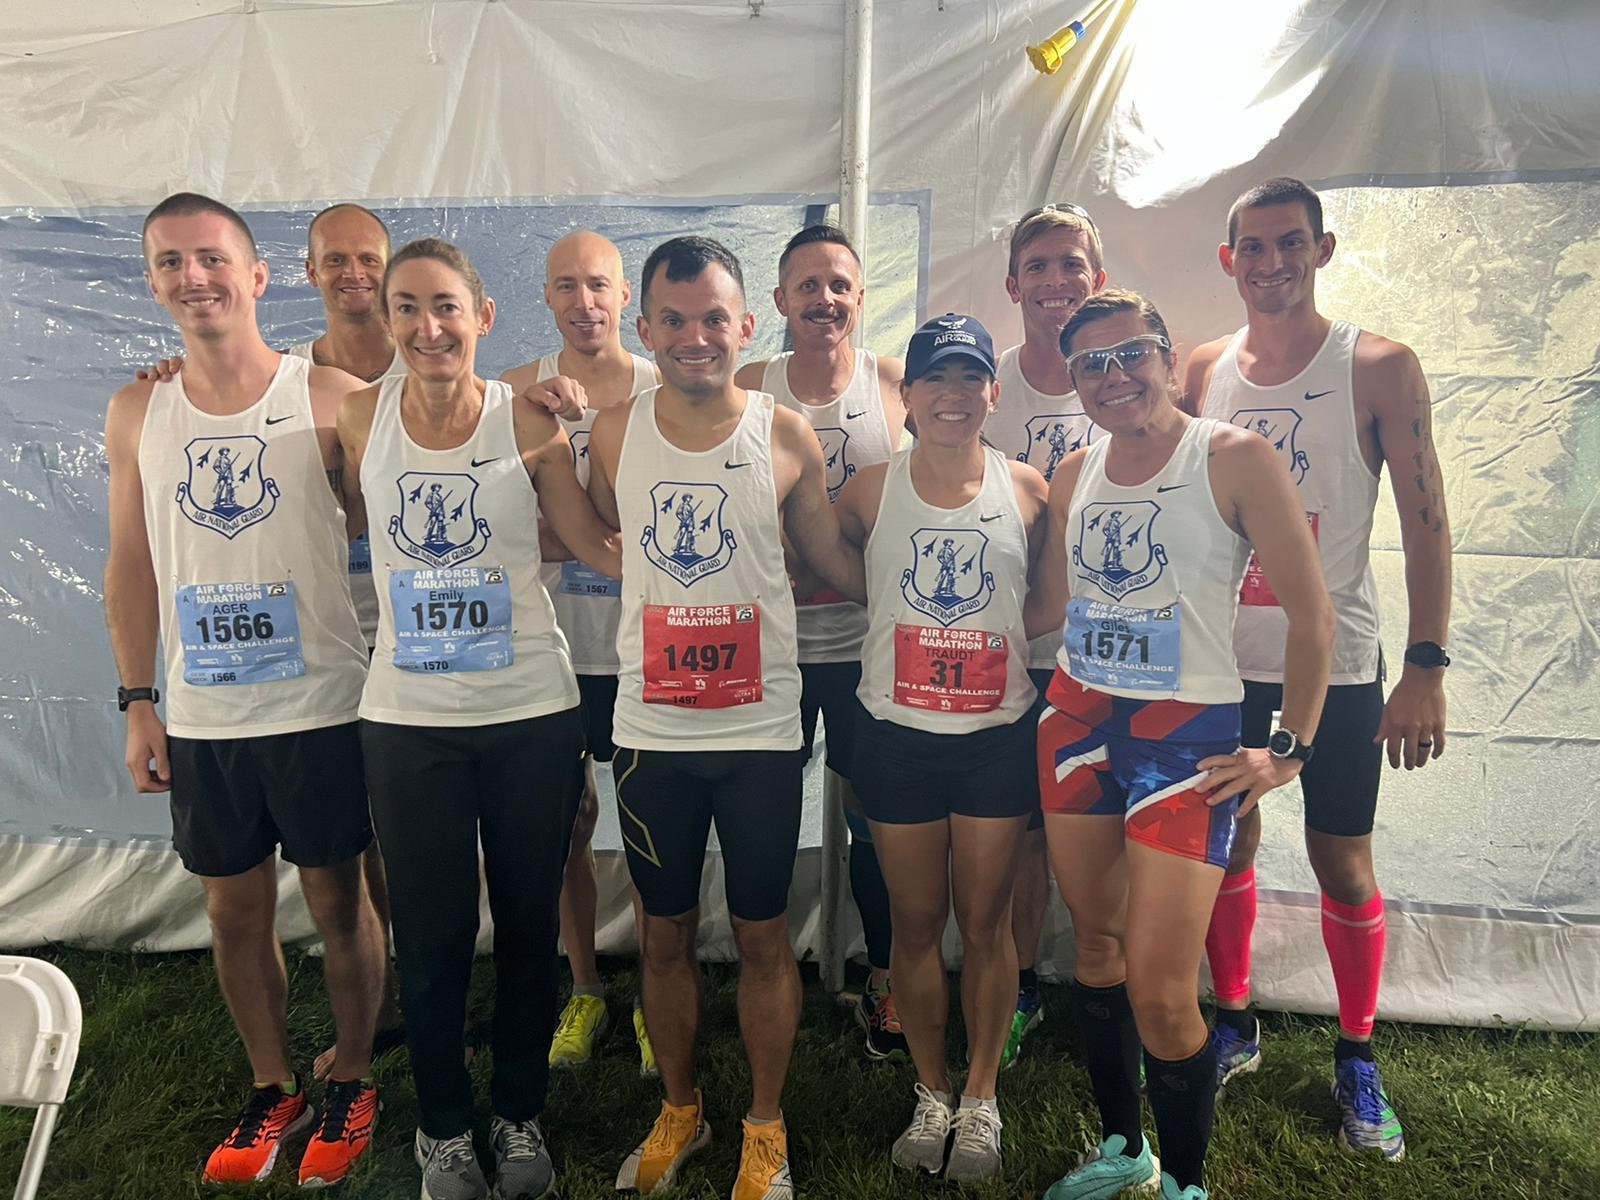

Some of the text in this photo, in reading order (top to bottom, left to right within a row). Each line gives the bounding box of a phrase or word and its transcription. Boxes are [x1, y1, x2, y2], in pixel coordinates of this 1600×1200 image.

[934, 333, 953, 347] AIR
[193, 510, 207, 522] AIR
[241, 507, 264, 523] GUARD
[406, 544, 420, 555] AIR
[451, 545, 475, 561] GUARD
[657, 555, 668, 568] AIR
[698, 558, 721, 573] GUARD
[414, 568, 479, 580] AIR FORCE
[1087, 571, 1101, 581] AIR
[195, 583, 261, 595] AIR FORCE
[412, 577, 480, 590] MARATHON
[195, 591, 263, 604] MARATHON
[429, 590, 464, 602] Emily
[212, 603, 250, 615] AGER
[667, 606, 731, 617] AIR FORCE
[913, 597, 927, 608] AIR
[958, 599, 980, 614] GUARD
[1088, 601, 1147, 616] AIR FORC
[411, 599, 489, 630] 1570
[667, 616, 731, 626] MARATHON
[196, 612, 274, 643] 1566
[421, 630, 449, 638] SPACE
[451, 625, 507, 637] CHALLENGE
[1101, 620, 1130, 633] Giles
[919, 628, 983, 641] AIR FORCE
[207, 643, 235, 651] SPACE
[237, 636, 295, 649] CHALLENGE
[918, 637, 982, 650] MARATHON
[1082, 630, 1149, 663] 1571
[664, 643, 738, 672] 1497
[924, 647, 975, 661] TRAUDT
[422, 660, 449, 671] 1570
[1088, 658, 1114, 668] SPACE
[1115, 662, 1175, 673] CHALLENGE
[211, 672, 237, 682] 1566
[929, 660, 963, 688] 31
[896, 681, 910, 689] AIR
[919, 684, 947, 694] SPACE
[949, 688, 1000, 696] CHALLENGE
[673, 695, 698, 705] 1497
